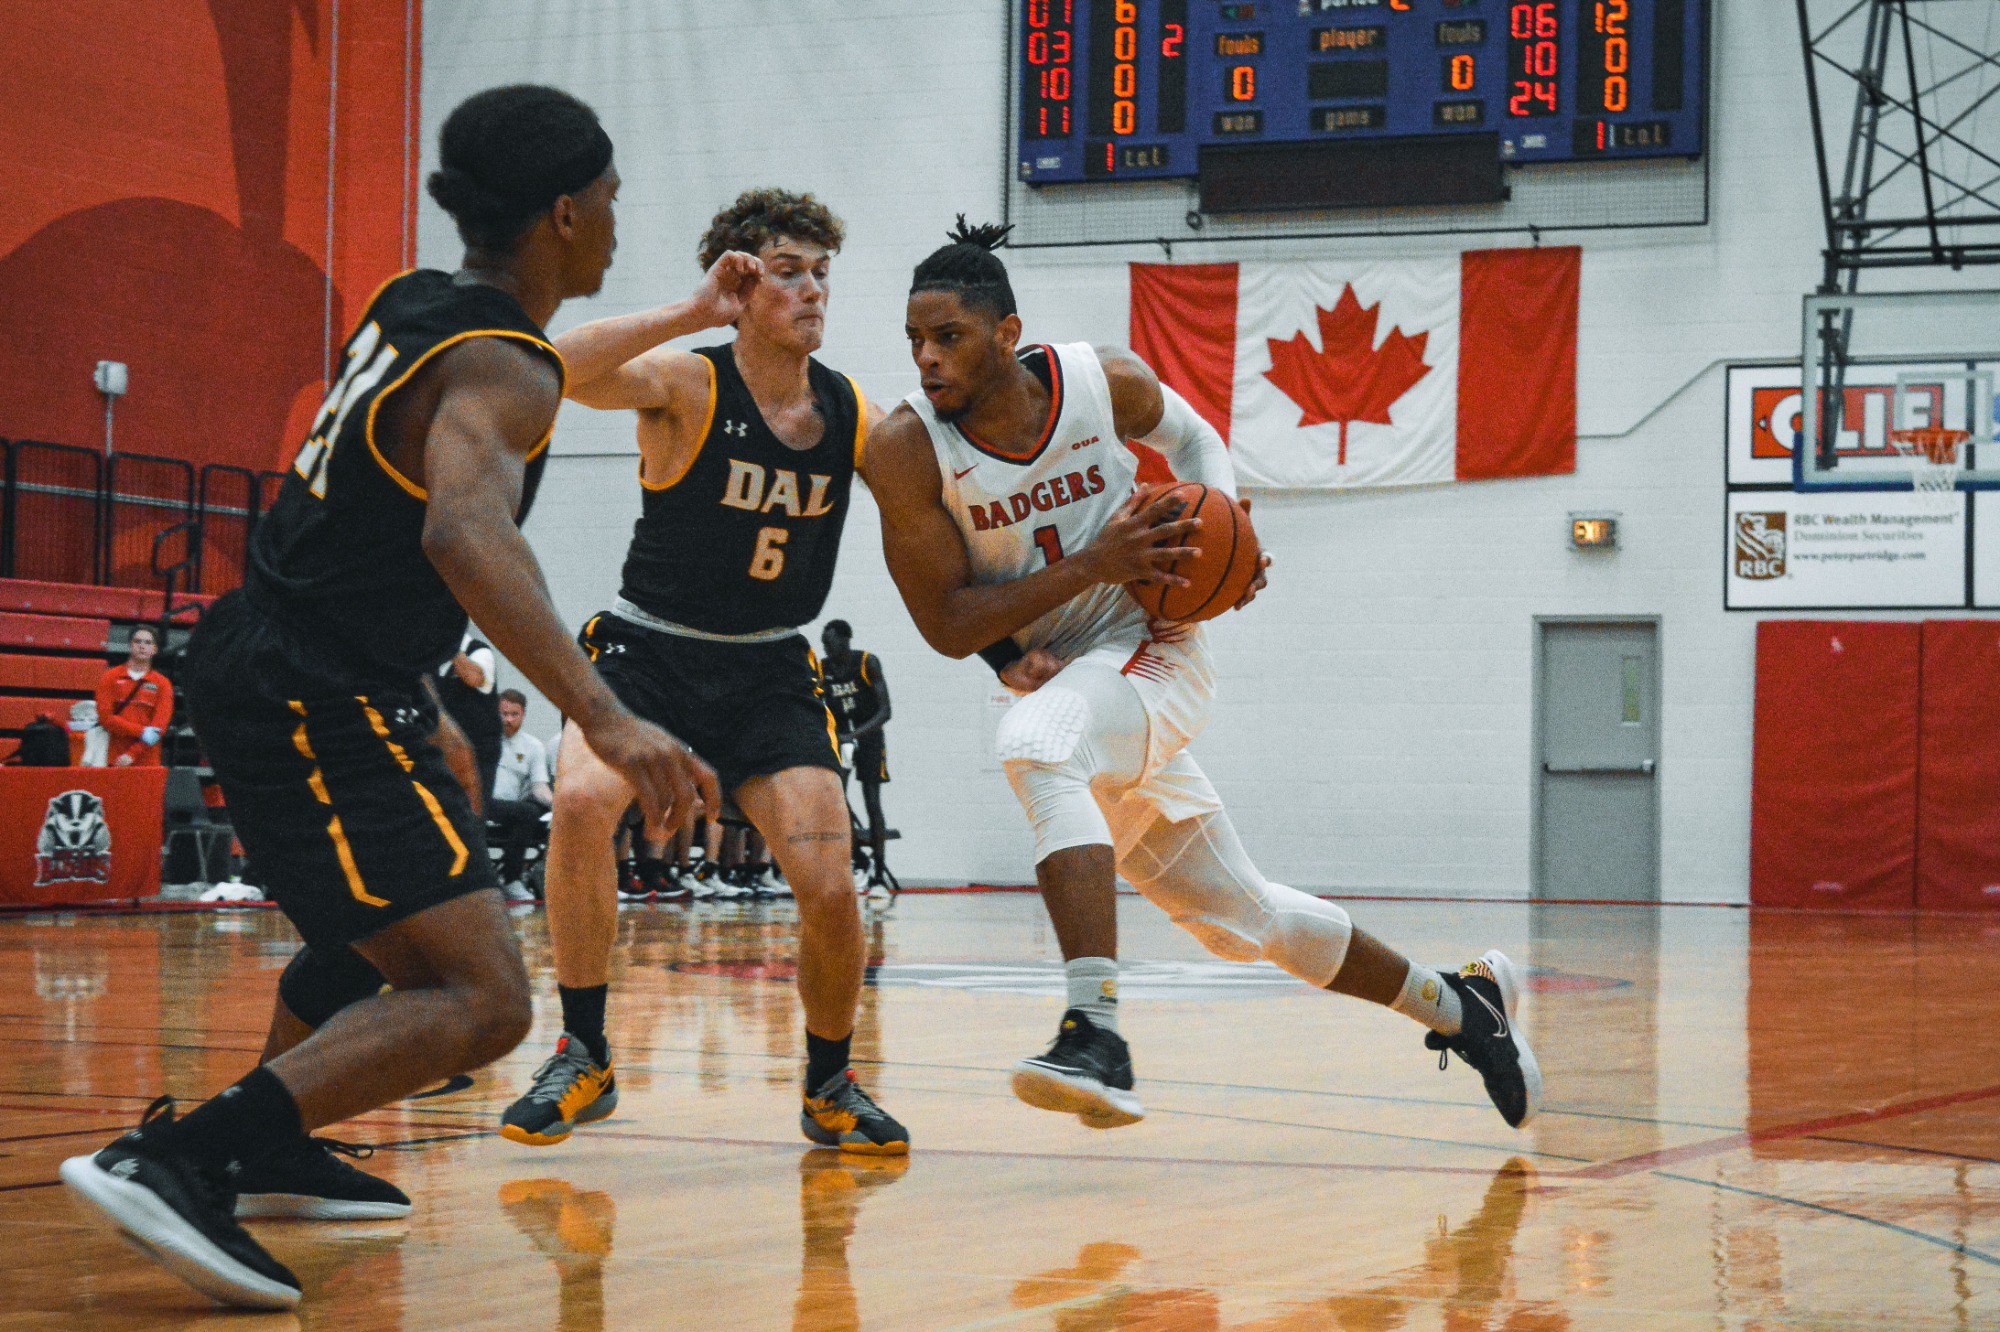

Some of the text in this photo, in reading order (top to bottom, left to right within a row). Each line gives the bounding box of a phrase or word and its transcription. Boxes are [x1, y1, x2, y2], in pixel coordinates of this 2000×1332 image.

[1115, 0, 1137, 24] 6
[1511, 3, 1557, 39] 06
[1595, 0, 1628, 35] 12
[1028, 31, 1071, 64] 03
[1114, 26, 1136, 61] 0
[1162, 24, 1184, 58] 2
[1523, 41, 1557, 76] 10
[1604, 37, 1628, 73] 0
[1041, 67, 1070, 101] 10
[1113, 63, 1135, 98] 0
[1232, 66, 1254, 100] 0
[1451, 54, 1475, 90] 0
[1510, 81, 1557, 116] 24
[1604, 75, 1628, 112] 0
[1040, 106, 1069, 135] 11
[1113, 100, 1135, 134] 0
[1071, 435, 1100, 451] OUA
[720, 458, 834, 517] DAL
[968, 464, 1106, 531] BADGERS
[1794, 512, 1955, 528] RBC Wealth Management
[1794, 530, 1923, 542] Dominion Securities
[748, 526, 789, 581] 6
[1033, 523, 1064, 566] 1
[1739, 560, 1784, 577] RBC
